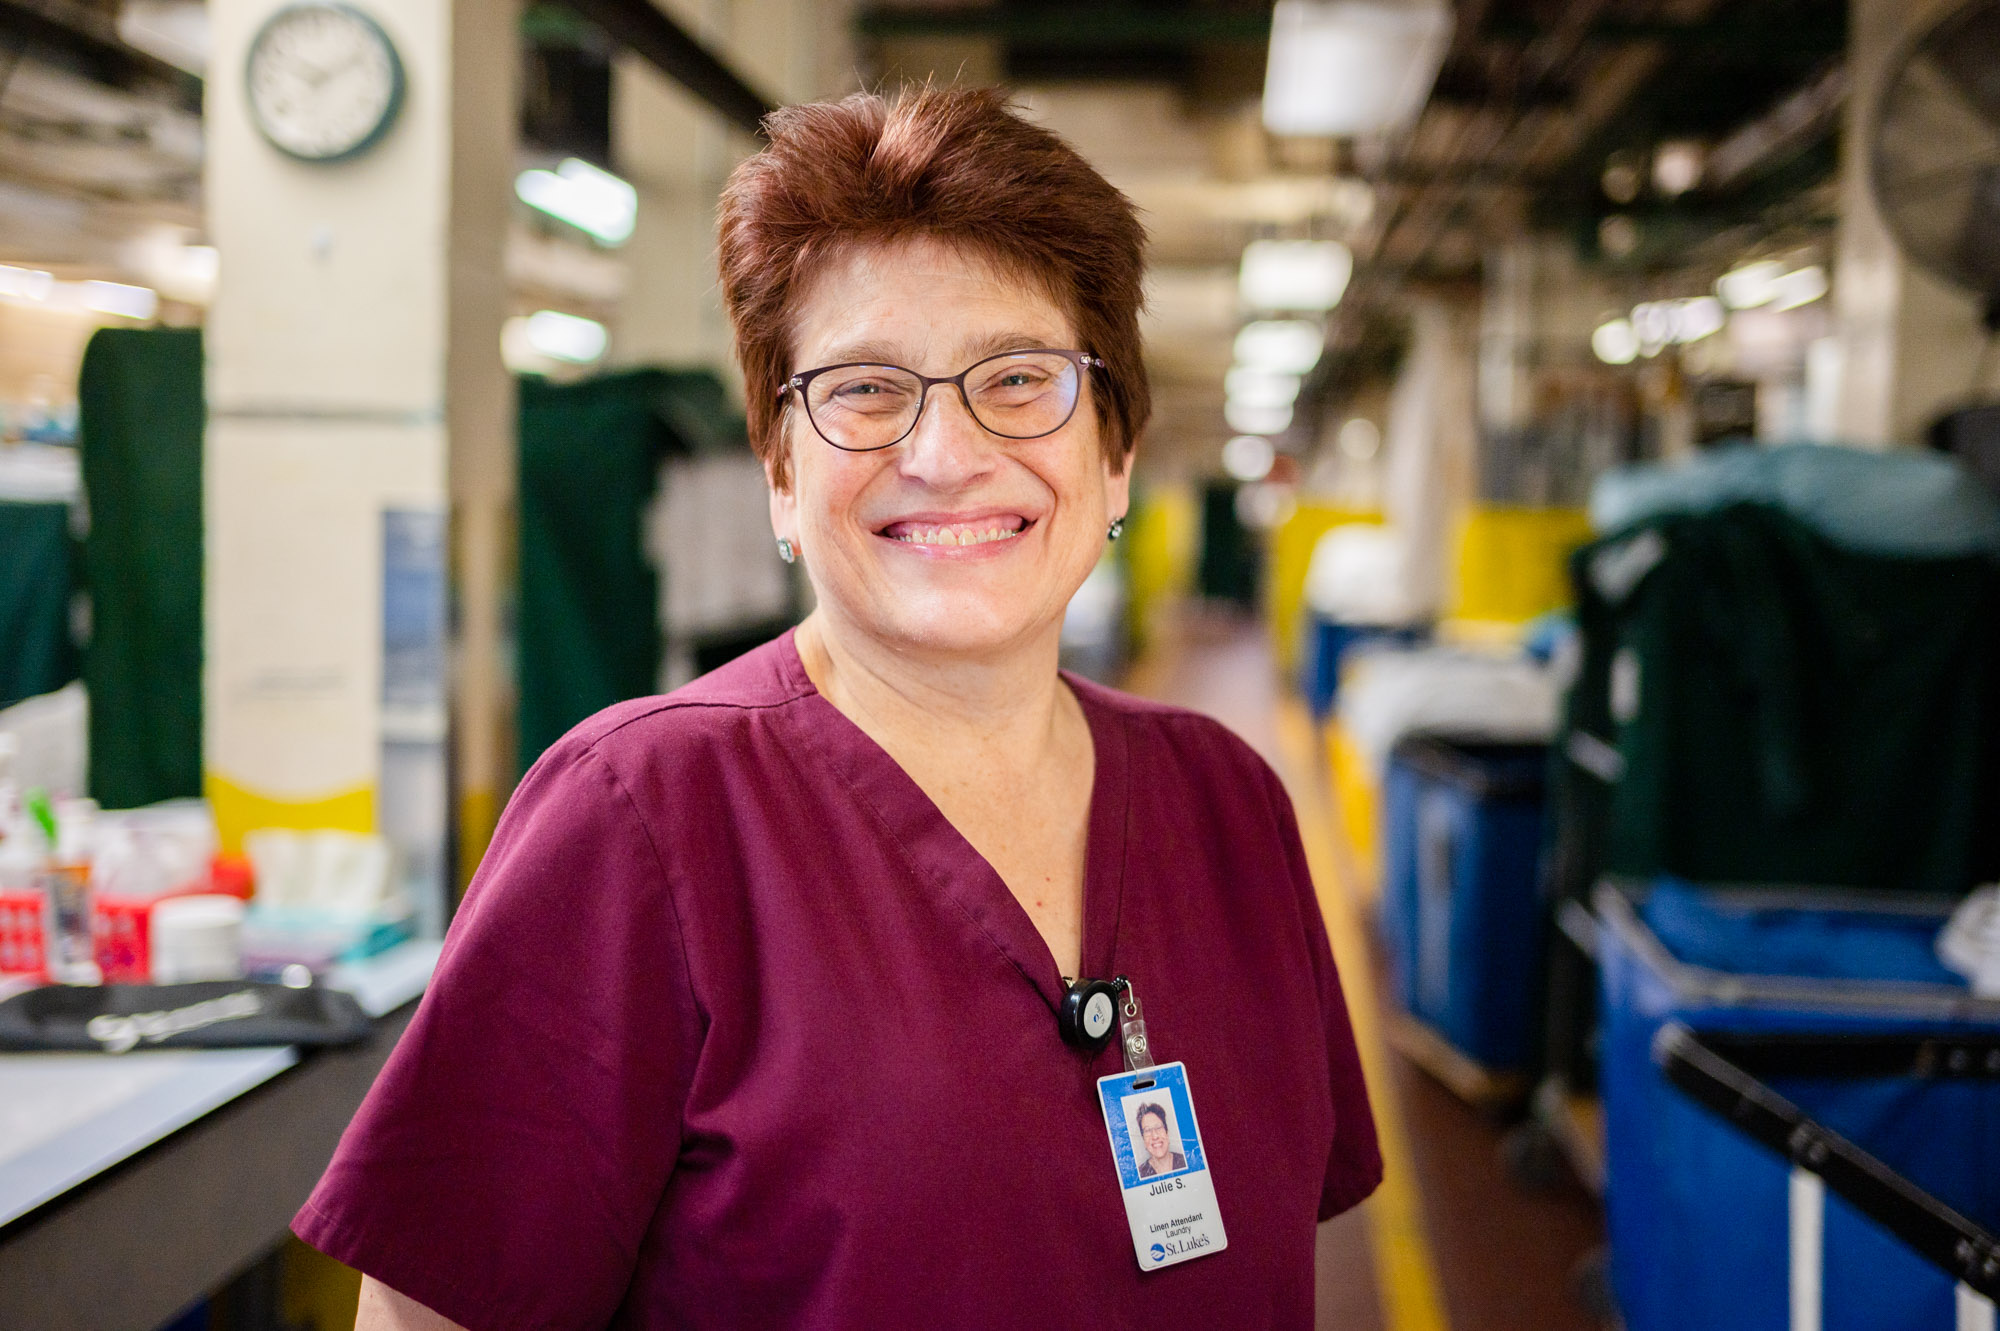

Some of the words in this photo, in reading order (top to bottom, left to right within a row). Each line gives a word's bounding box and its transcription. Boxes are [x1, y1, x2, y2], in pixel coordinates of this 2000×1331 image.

[1149, 1181, 1173, 1196] Julie
[1175, 1178, 1186, 1190] S.
[1149, 1221, 1169, 1233] Linen
[1170, 1212, 1203, 1228] Attendant
[1165, 1225, 1192, 1239] Laundry
